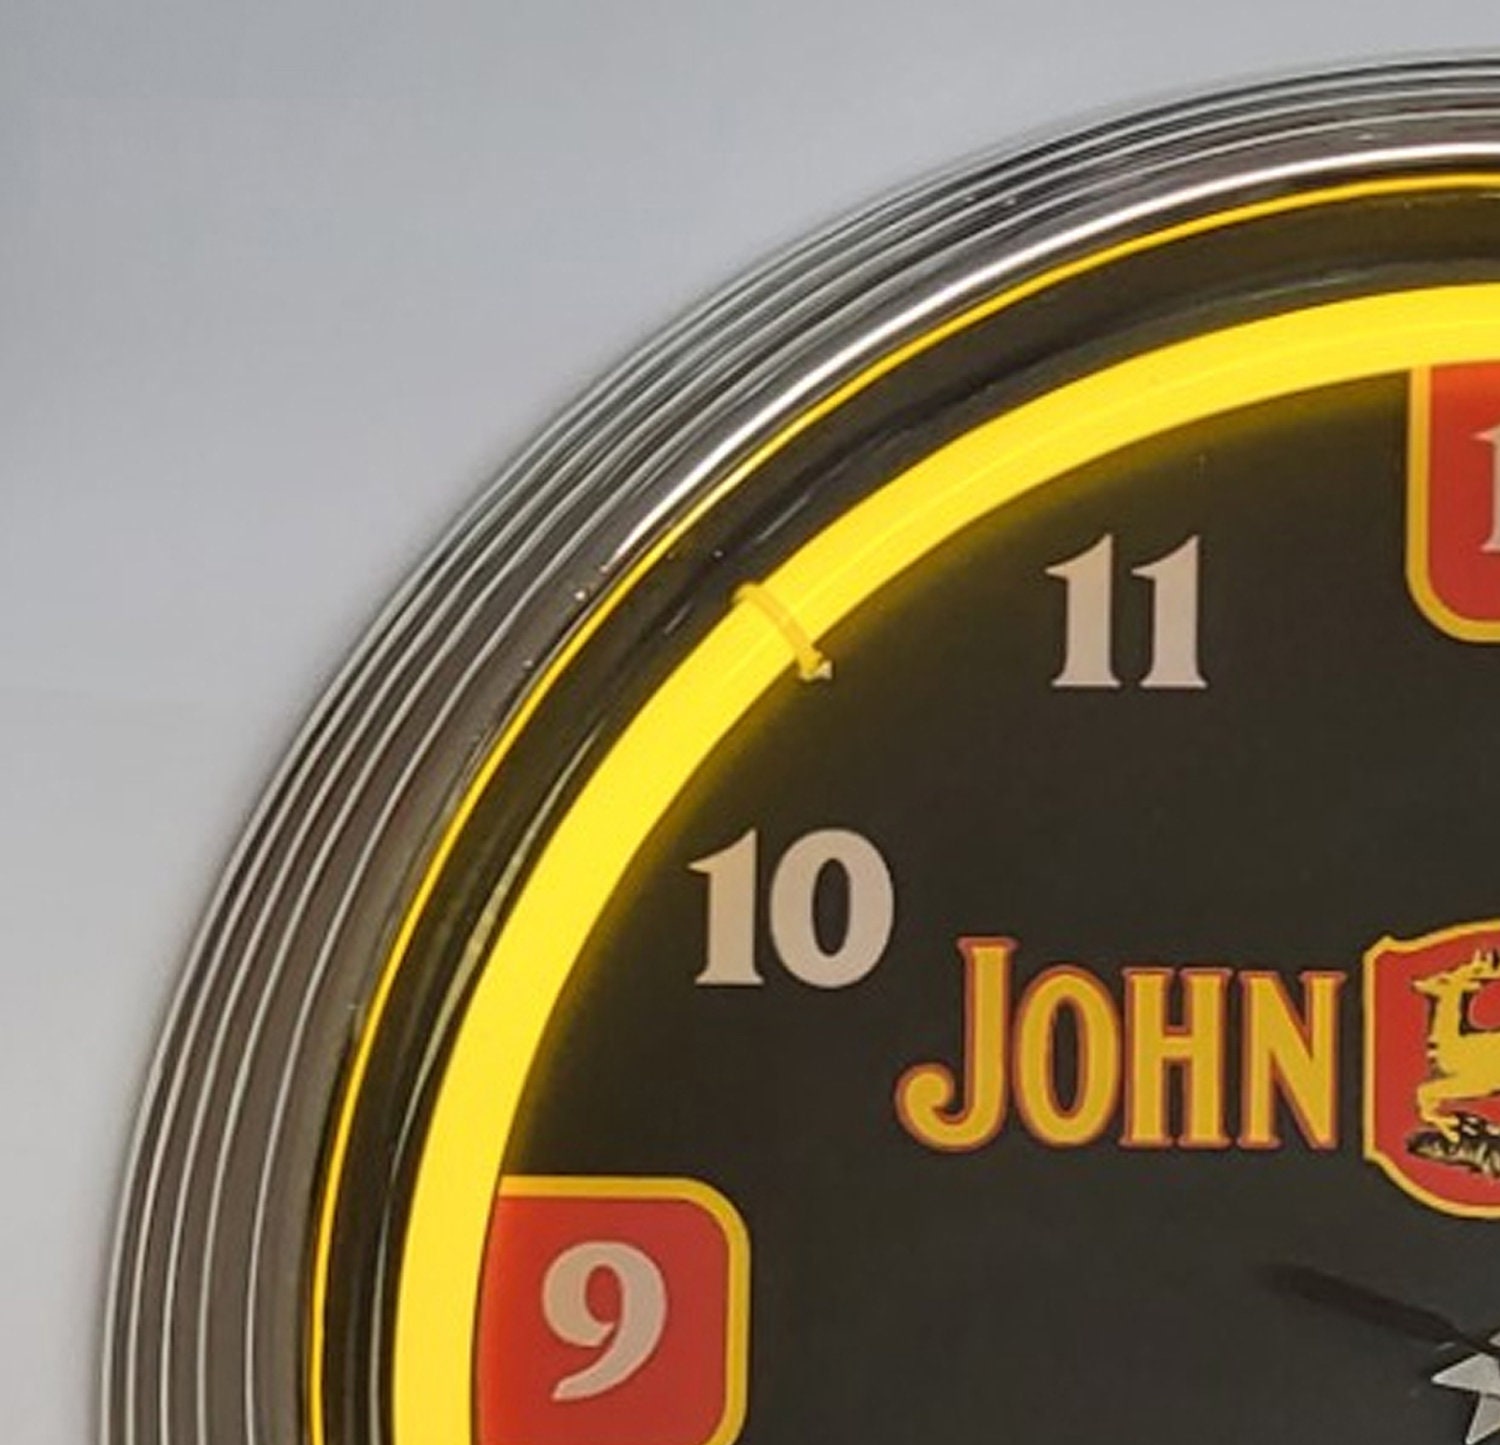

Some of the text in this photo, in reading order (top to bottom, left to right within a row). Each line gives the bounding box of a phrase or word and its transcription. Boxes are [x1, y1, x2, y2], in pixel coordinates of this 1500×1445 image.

[1045, 534, 1208, 690] 11
[688, 829, 894, 988] 10
[896, 938, 1343, 1153] JOHN
[542, 1242, 666, 1402] 9
